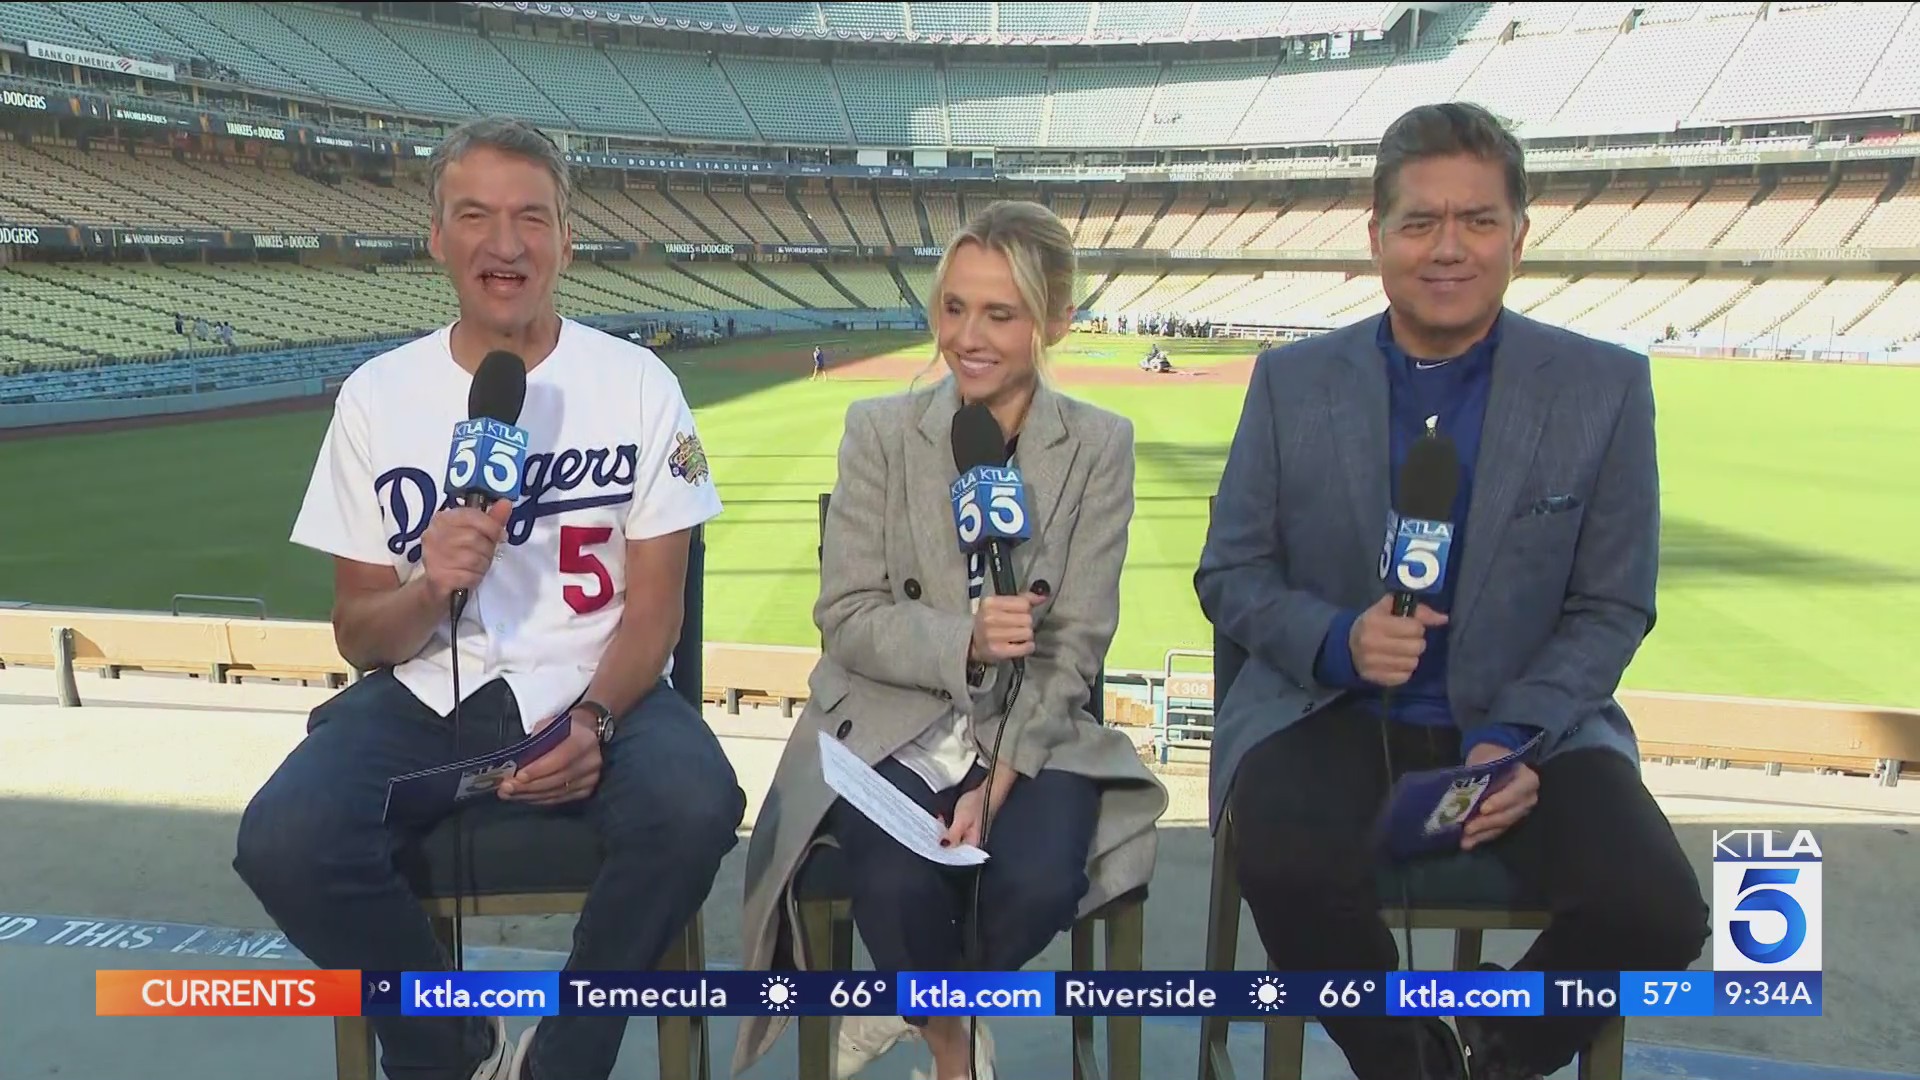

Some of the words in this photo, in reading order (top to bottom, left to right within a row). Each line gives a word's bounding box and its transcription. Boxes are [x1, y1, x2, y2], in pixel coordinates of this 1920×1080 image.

[38, 48, 64, 61] BANK
[65, 53, 76, 62] OF
[78, 55, 116, 70] AMERICA
[3, 91, 47, 110] DODGERS
[124, 110, 147, 122] WORLD
[226, 122, 252, 138] YANKEES
[258, 126, 285, 141] DODGERS
[602, 157, 618, 165] TO
[628, 158, 685, 168] DODGER
[696, 161, 760, 171] STADIUM
[132, 234, 160, 245] WORLD
[253, 234, 284, 249] YANKEES
[289, 235, 320, 249] DODGERS
[664, 243, 695, 254] YANKEES
[701, 243, 734, 254] DODGERS
[455, 421, 484, 437] KTLA
[487, 421, 526, 446] KTLA
[449, 438, 478, 489] 5
[483, 441, 520, 493] 5
[951, 472, 977, 497] KTLA
[980, 468, 1020, 482] KTLA
[374, 444, 638, 563] Dgers
[989, 486, 1025, 535] 5
[958, 489, 982, 543] 5
[1400, 519, 1450, 537] KTLA
[559, 525, 615, 614] 5
[1396, 539, 1441, 591] 5
[1181, 682, 1208, 695] 308
[0, 916, 38, 940] D
